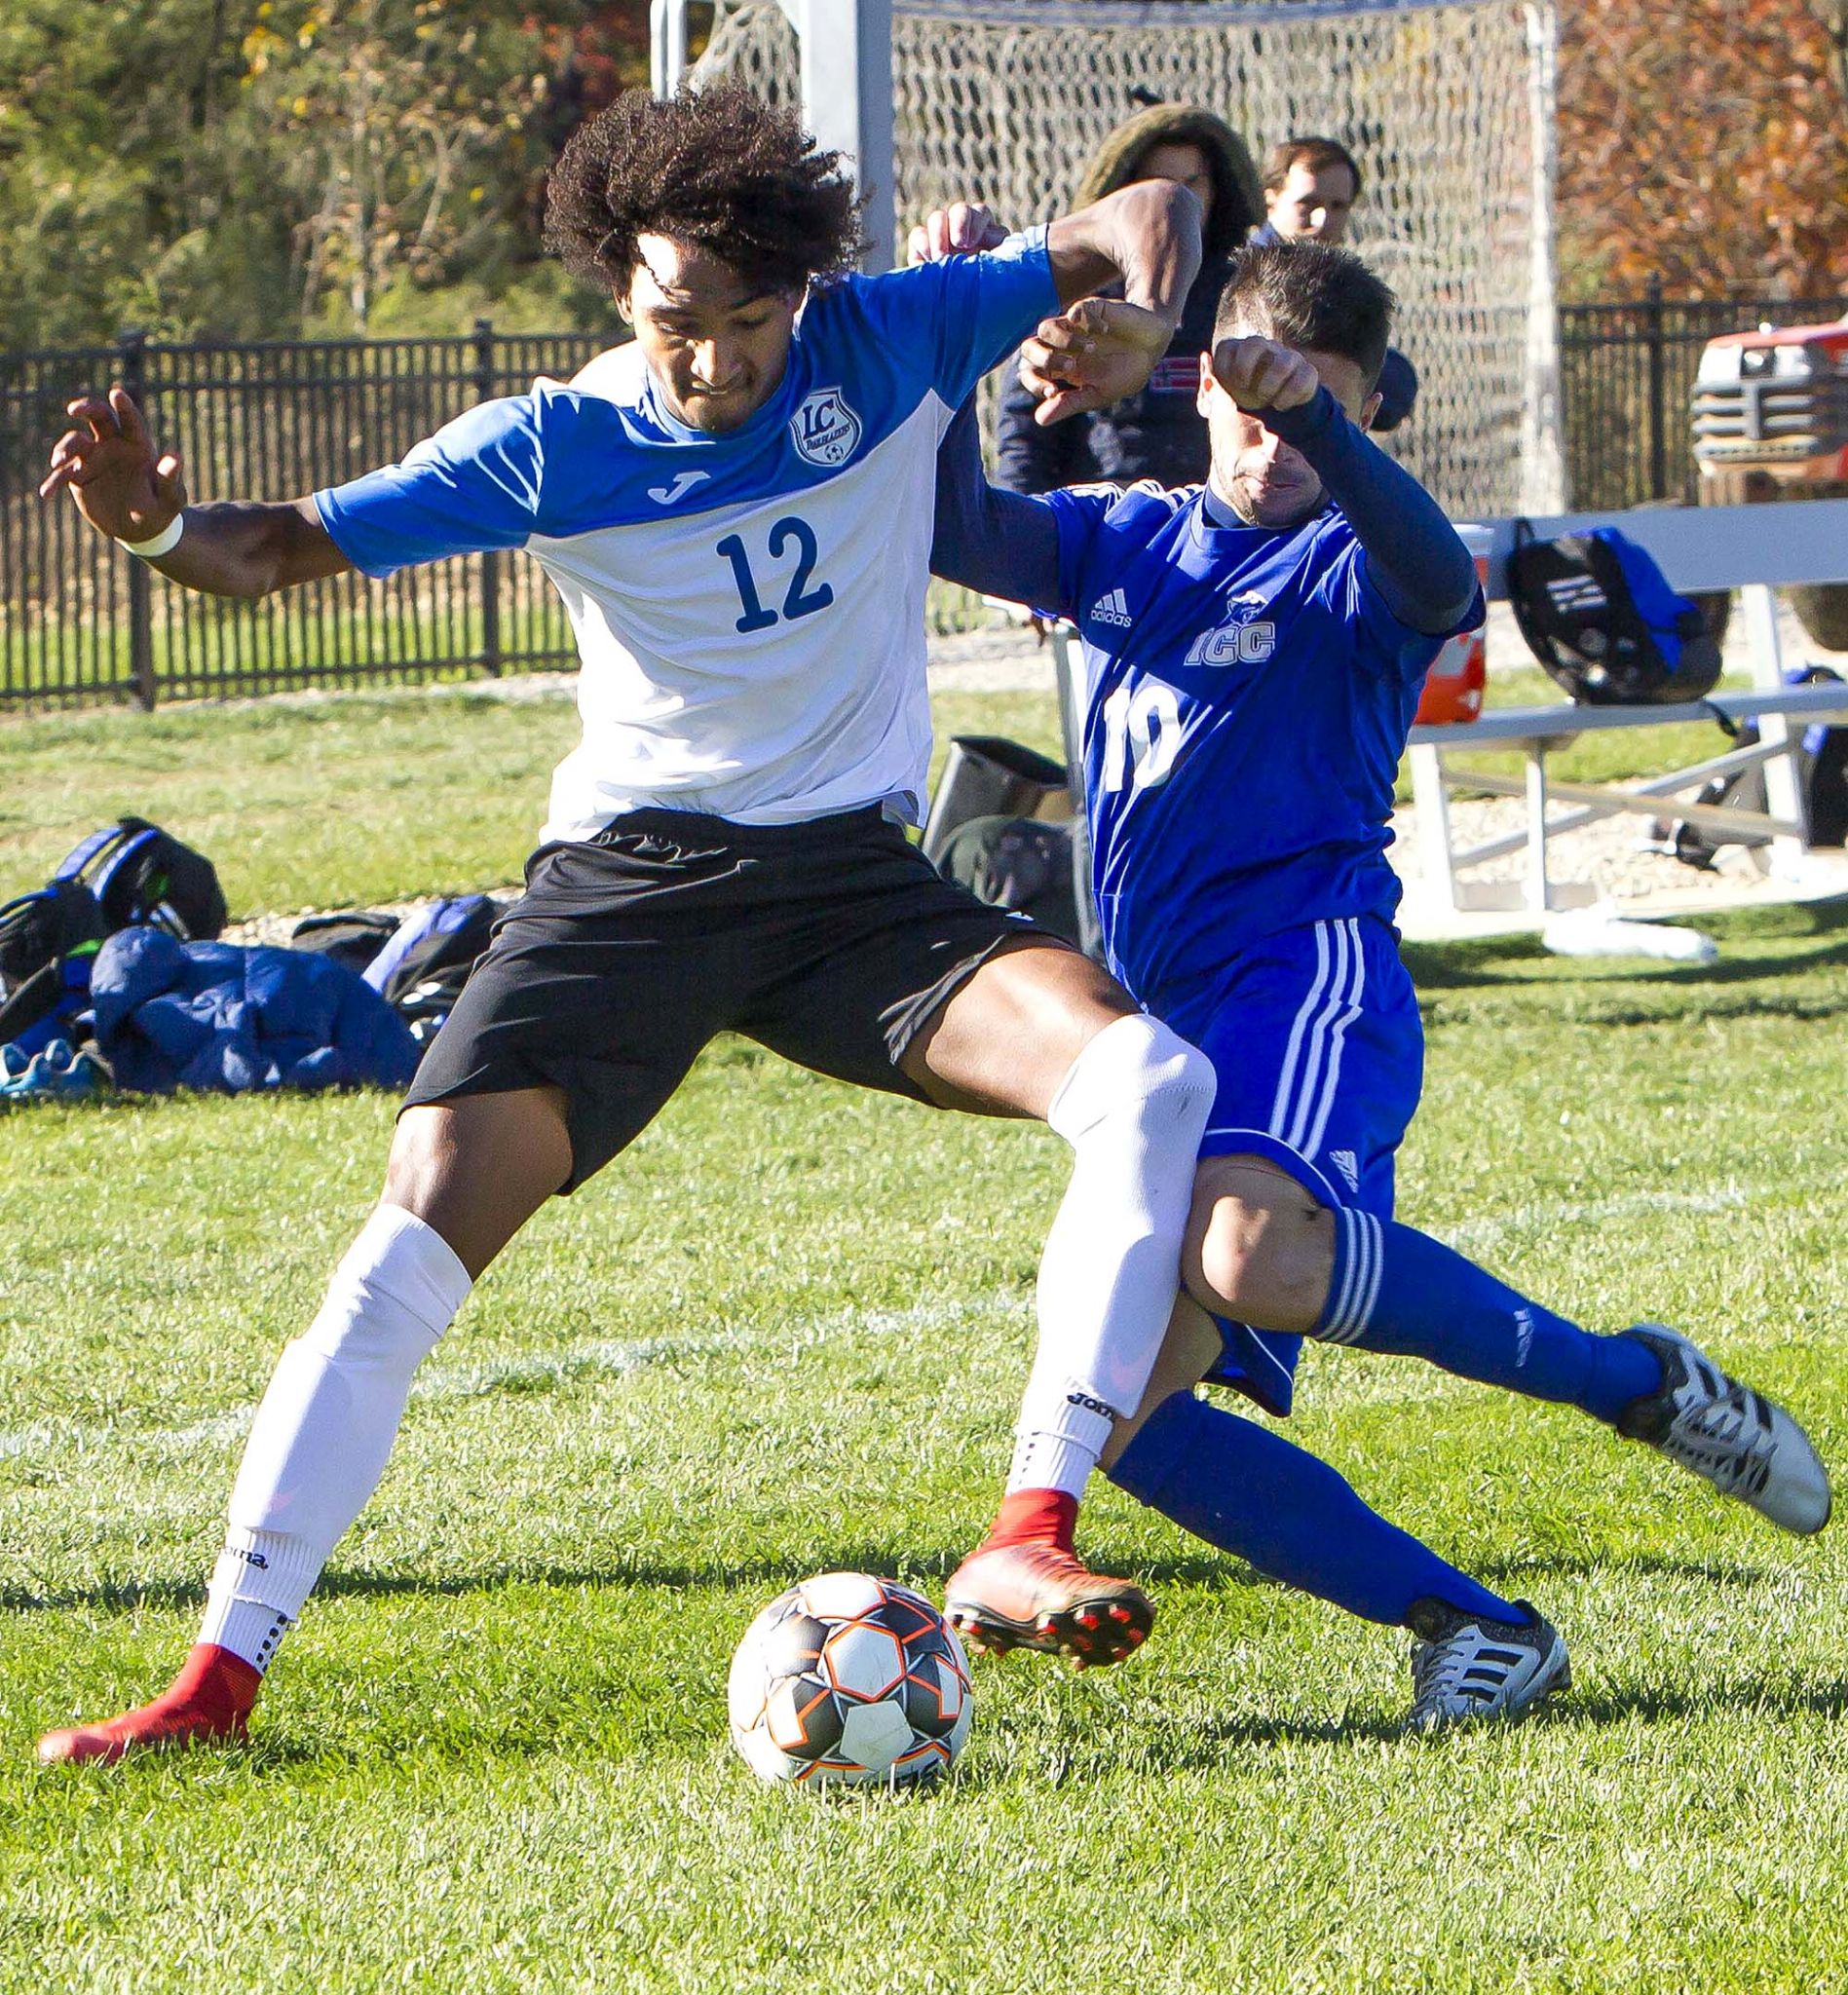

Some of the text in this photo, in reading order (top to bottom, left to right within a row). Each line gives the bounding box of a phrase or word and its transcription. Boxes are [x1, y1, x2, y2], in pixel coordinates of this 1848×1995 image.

[803, 397, 836, 440] LC
[716, 515, 835, 633] 12
[1090, 609, 1133, 628] adidas
[1183, 621, 1275, 666] ICC
[1067, 1391, 1115, 1424] Jom
[224, 1545, 269, 1570] oma
